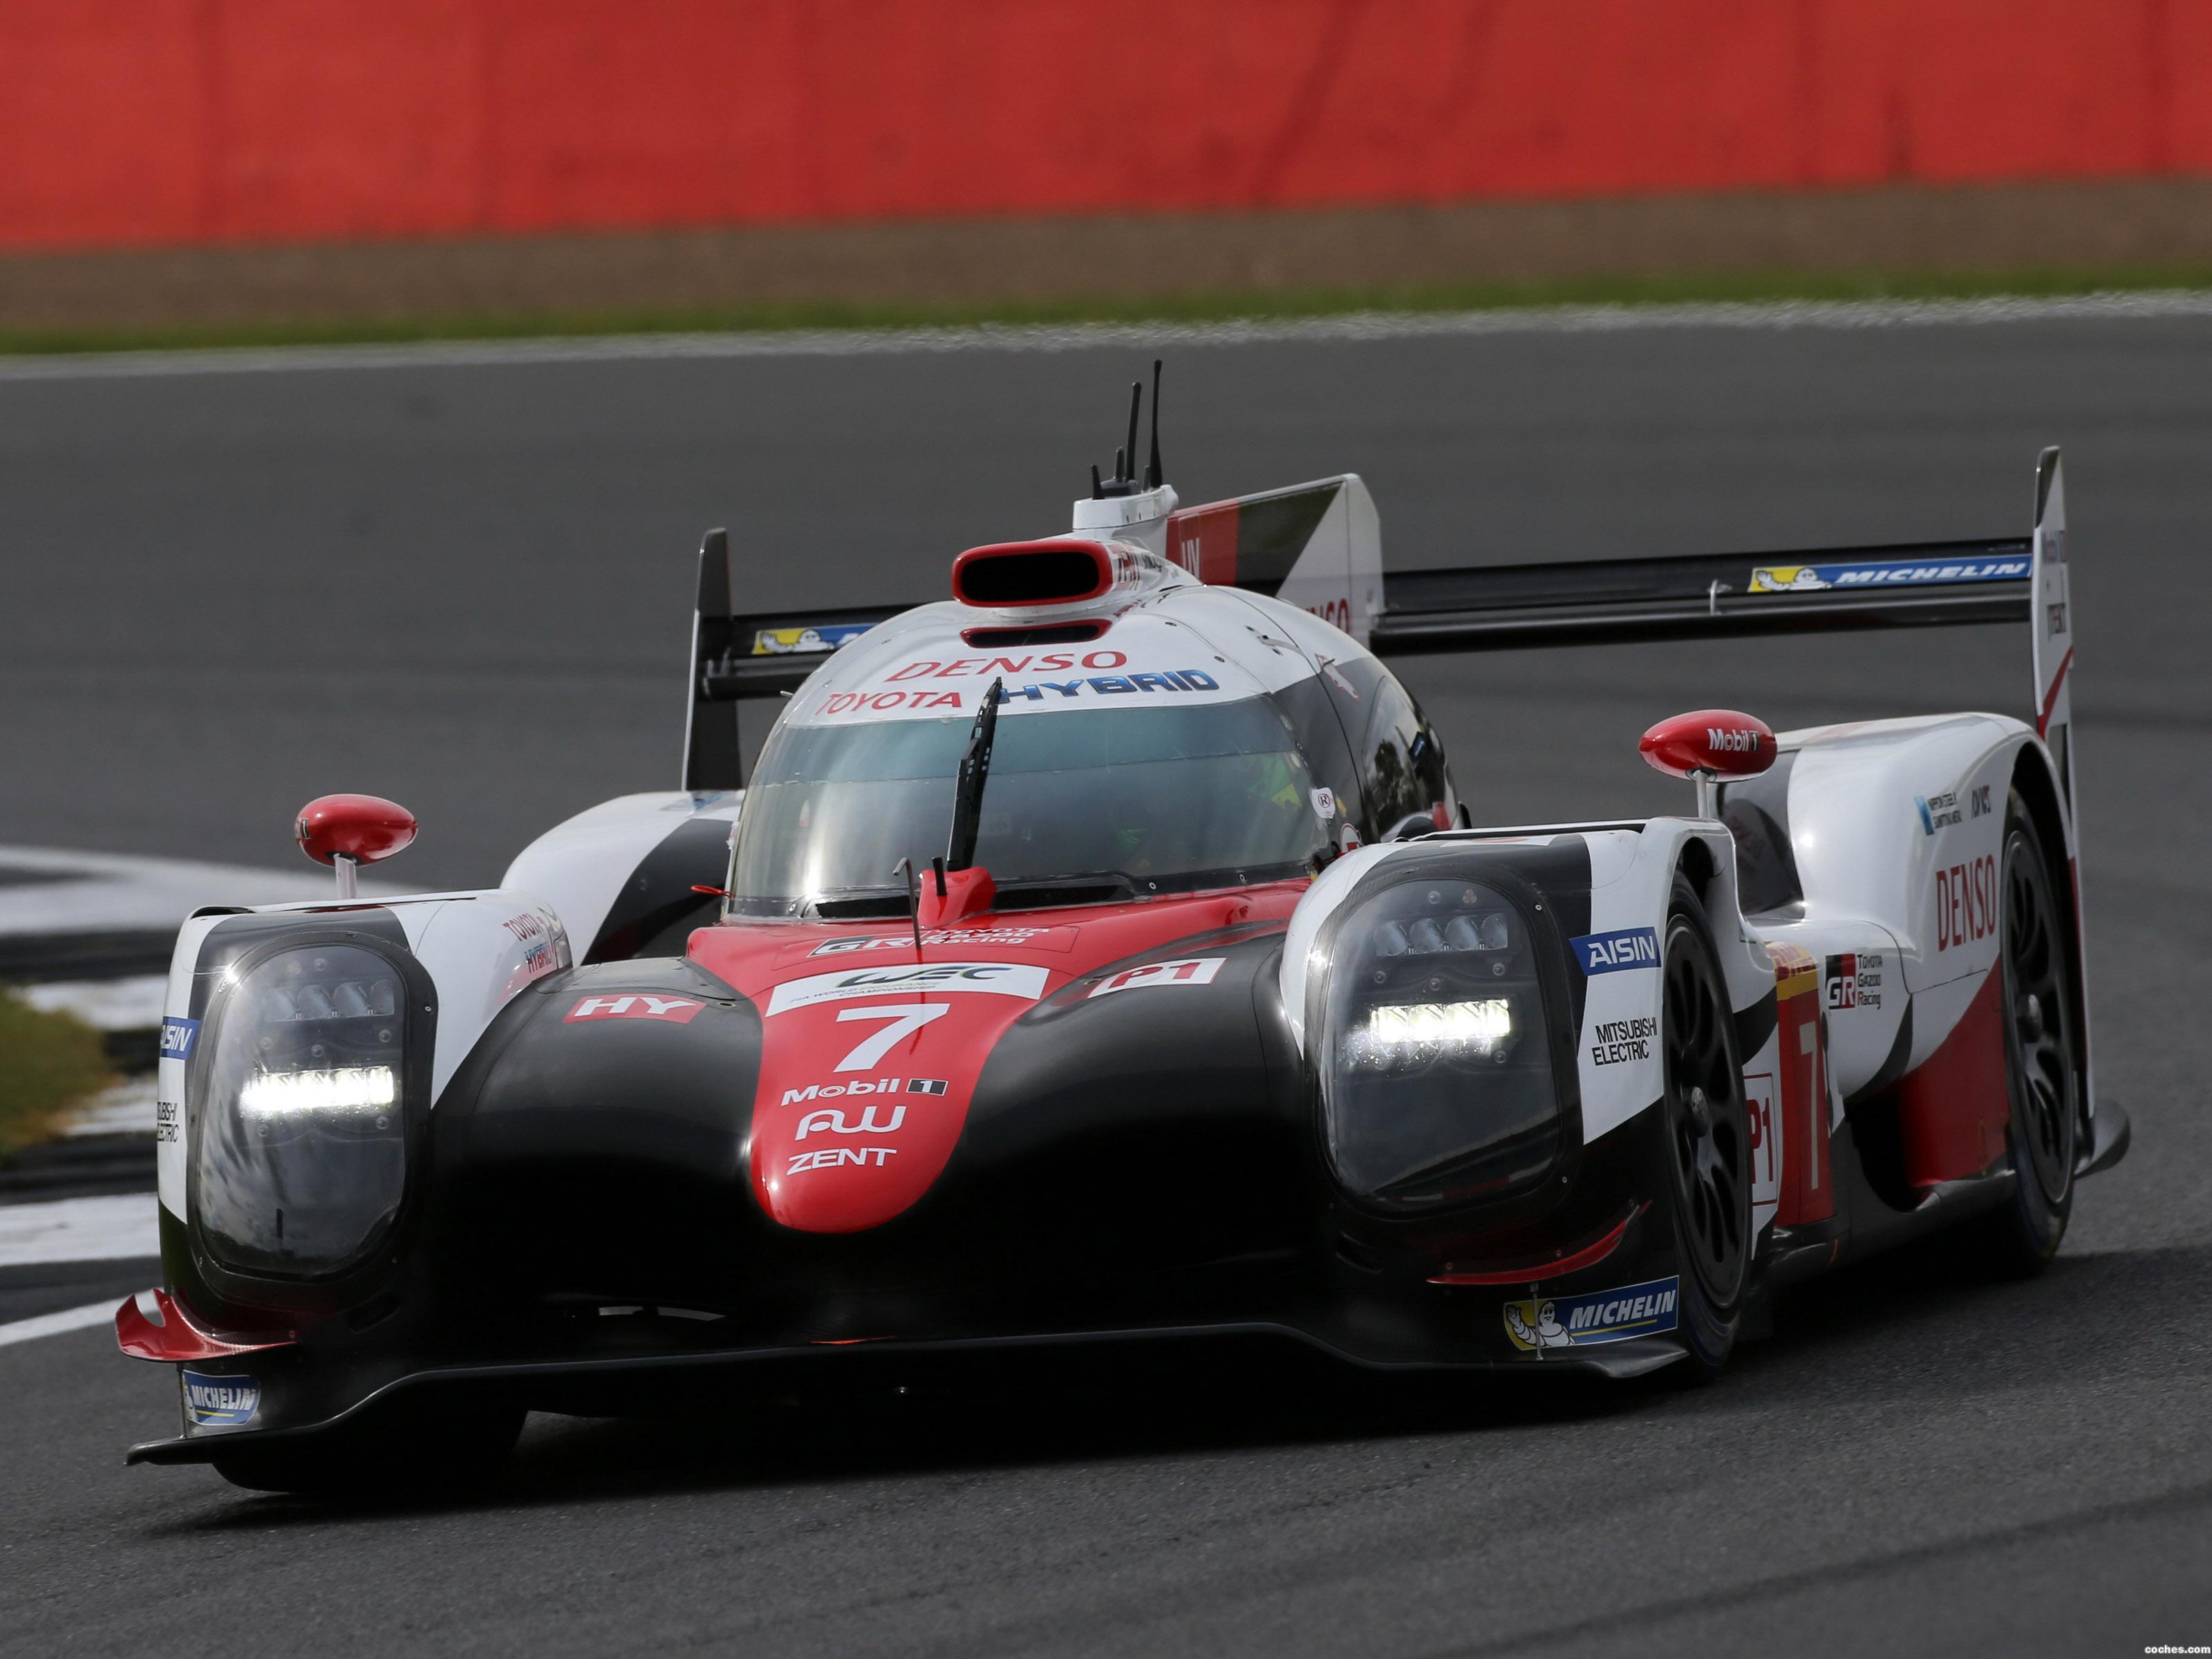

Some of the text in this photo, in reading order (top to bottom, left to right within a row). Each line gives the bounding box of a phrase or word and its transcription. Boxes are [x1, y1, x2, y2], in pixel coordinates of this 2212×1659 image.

[1835, 563, 2026, 583] MICHELIN
[883, 650, 1127, 683] DENSO
[815, 668, 1219, 716] TOYOTA HYBRID
[1707, 728, 1749, 752] Mobil
[1936, 854, 1996, 952] DENSO
[815, 937, 916, 954] GR
[920, 937, 1026, 945] Racing
[1588, 935, 1656, 968] AISIN
[1857, 954, 1883, 969] TOYOTA
[836, 966, 1013, 988] WEC
[1108, 962, 1201, 989] P1
[1826, 975, 1855, 1006] GR
[1857, 991, 1881, 1010] Racing
[574, 997, 696, 1017] HY
[833, 1003, 951, 1072] 7
[1595, 1017, 1658, 1044] MITSUBISHI
[1591, 1040, 1649, 1066] ELECTRIC
[780, 1078, 933, 1107] Mobil 1
[1799, 1021, 1819, 1190] 7
[786, 1147, 897, 1176] ZENT
[1569, 1290, 1677, 1329] MICHELIN
[191, 1385, 256, 1411] MICHELIN
